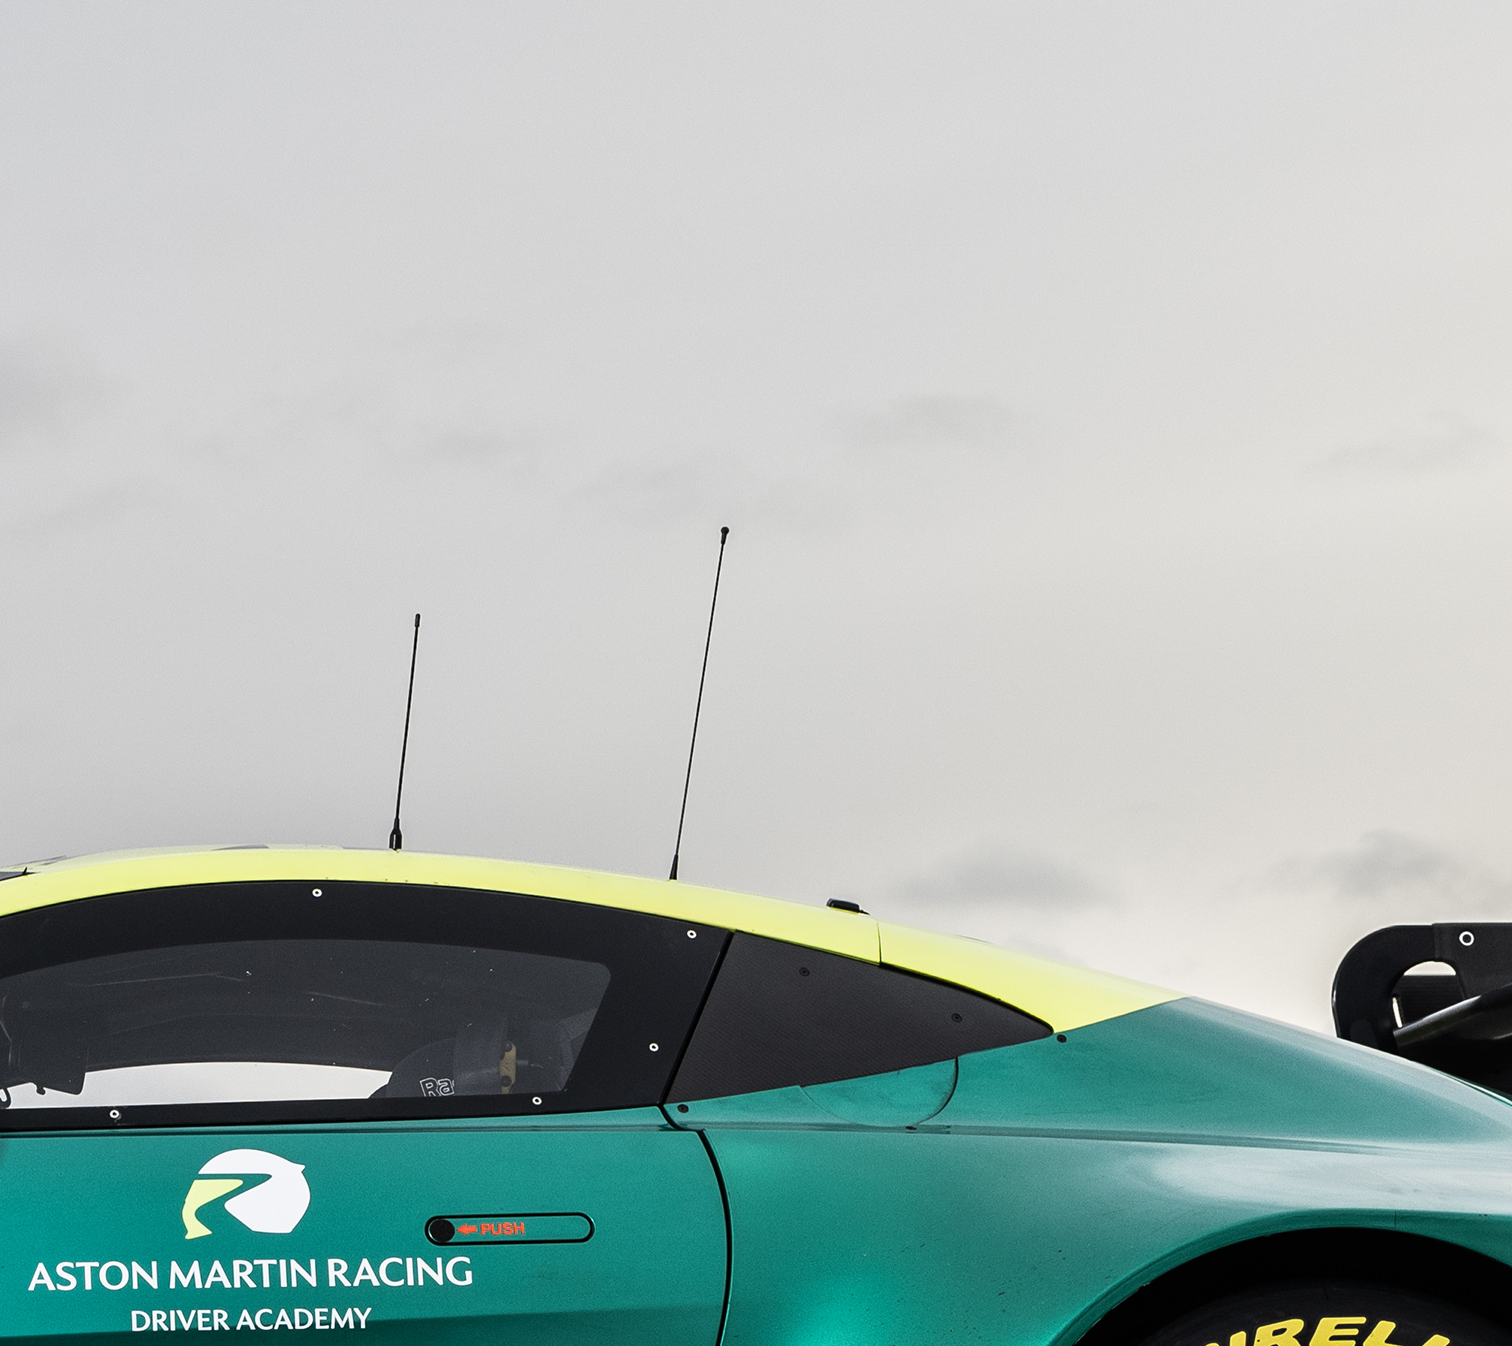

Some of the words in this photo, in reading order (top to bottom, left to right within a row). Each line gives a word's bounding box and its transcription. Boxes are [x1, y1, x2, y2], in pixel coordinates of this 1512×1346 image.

[419, 1077, 454, 1097] Ra
[480, 1222, 525, 1236] PUSH
[27, 1260, 158, 1291] ASTON
[169, 1258, 317, 1289] MARTIN
[328, 1256, 473, 1287] RACING
[131, 1309, 230, 1332] DRIVER
[236, 1307, 372, 1331] ACADEMY
